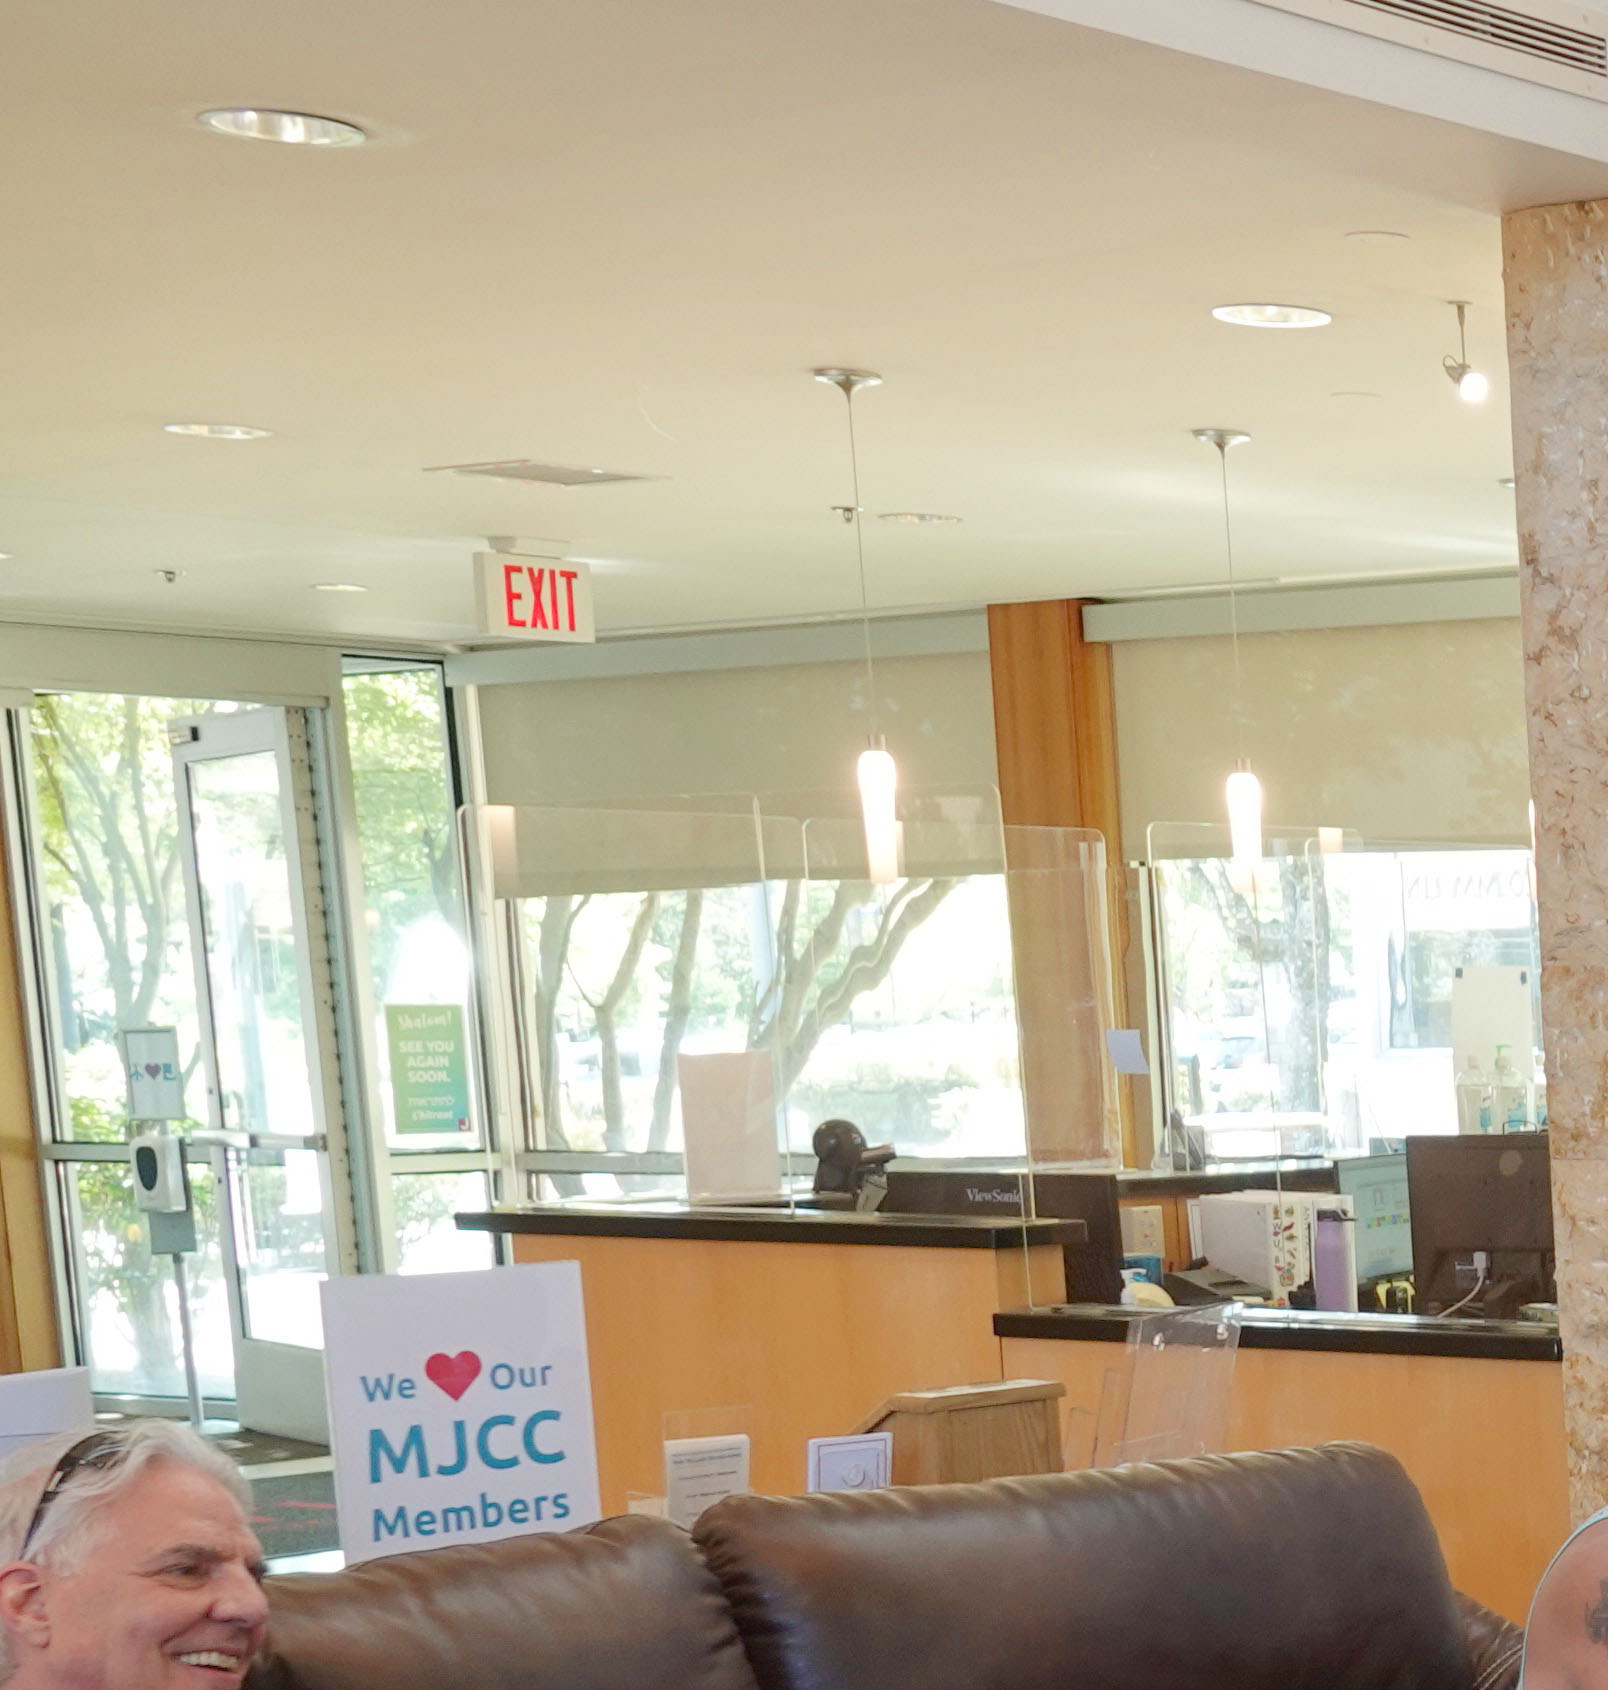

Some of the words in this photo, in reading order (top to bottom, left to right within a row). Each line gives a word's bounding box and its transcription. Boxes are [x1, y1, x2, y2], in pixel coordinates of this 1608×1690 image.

[504, 565, 578, 632] EXIT
[399, 1041, 424, 1053] SEE
[427, 1040, 454, 1052] YOU
[407, 1055, 449, 1068] AGAIN
[360, 1373, 416, 1403] We
[489, 1362, 553, 1391] Our
[369, 1410, 566, 1484] MJCC
[373, 1492, 570, 1541] Members
